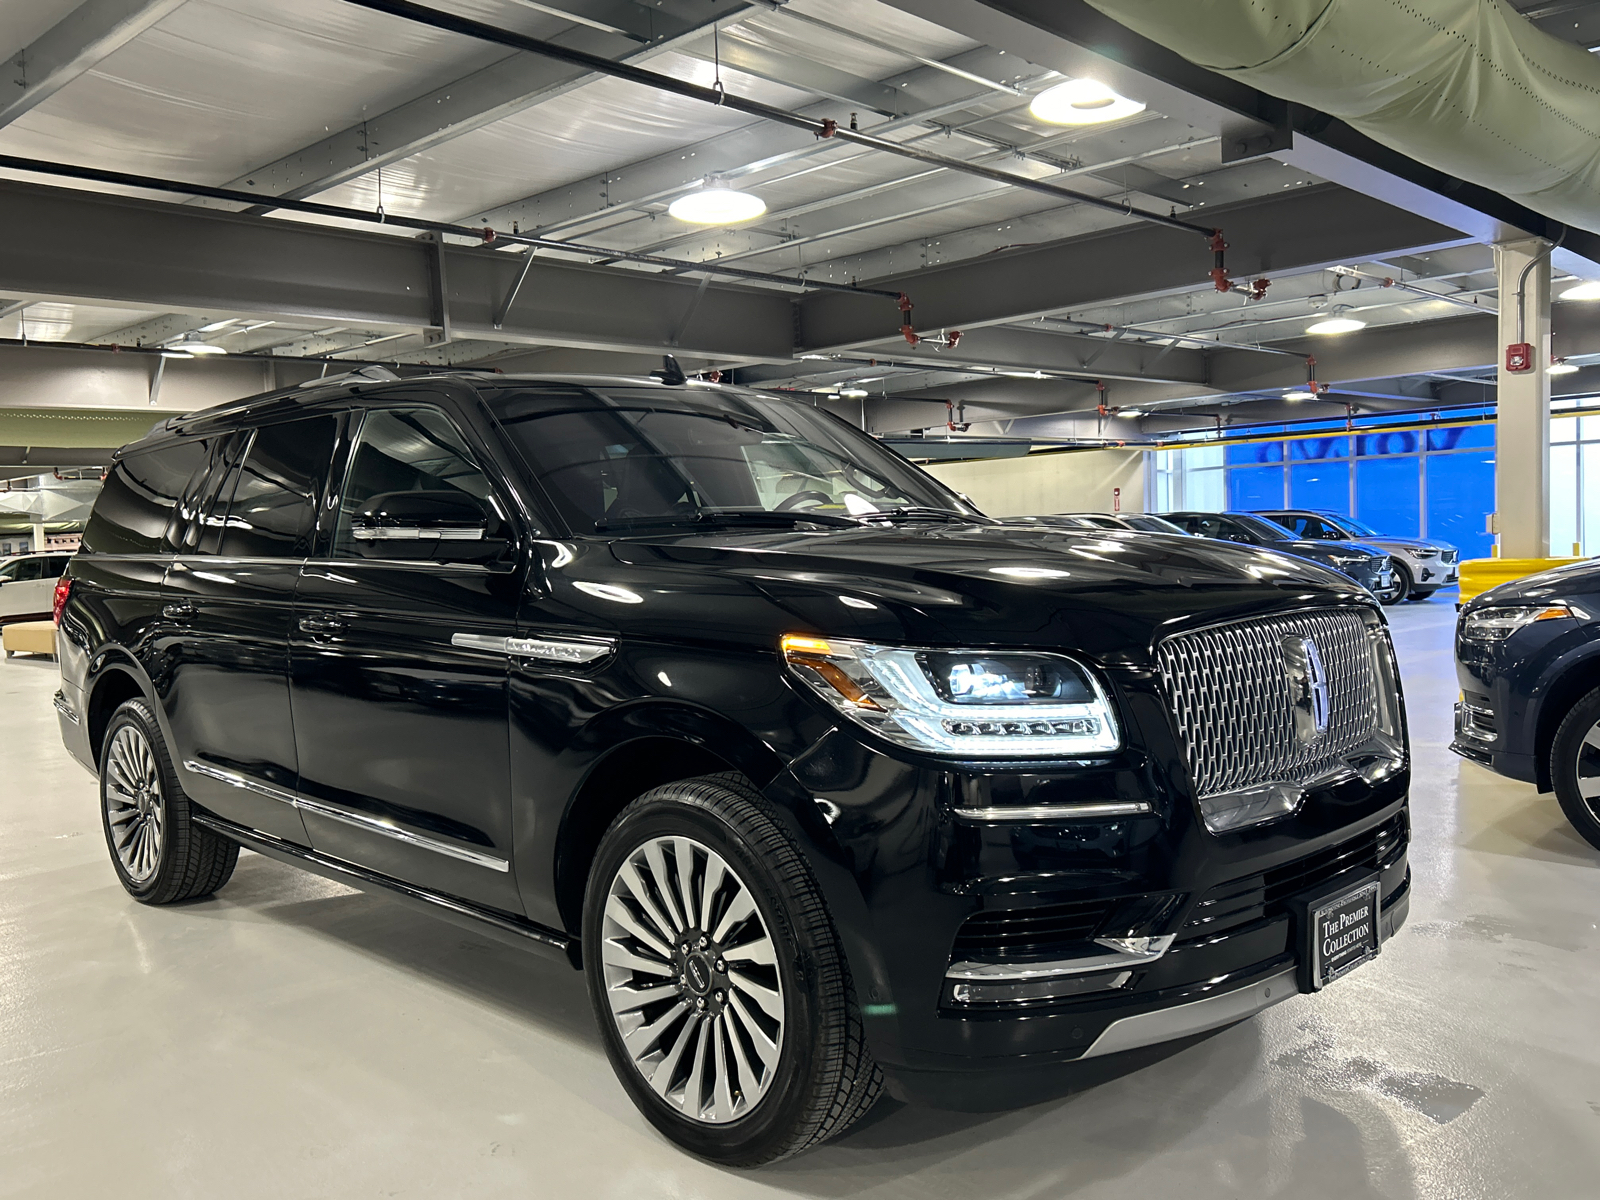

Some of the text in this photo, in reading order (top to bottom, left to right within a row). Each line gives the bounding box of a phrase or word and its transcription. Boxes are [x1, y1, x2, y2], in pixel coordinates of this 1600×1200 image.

[1323, 906, 1369, 939] THE PREMIER
[1323, 922, 1369, 957] COLLECTION
